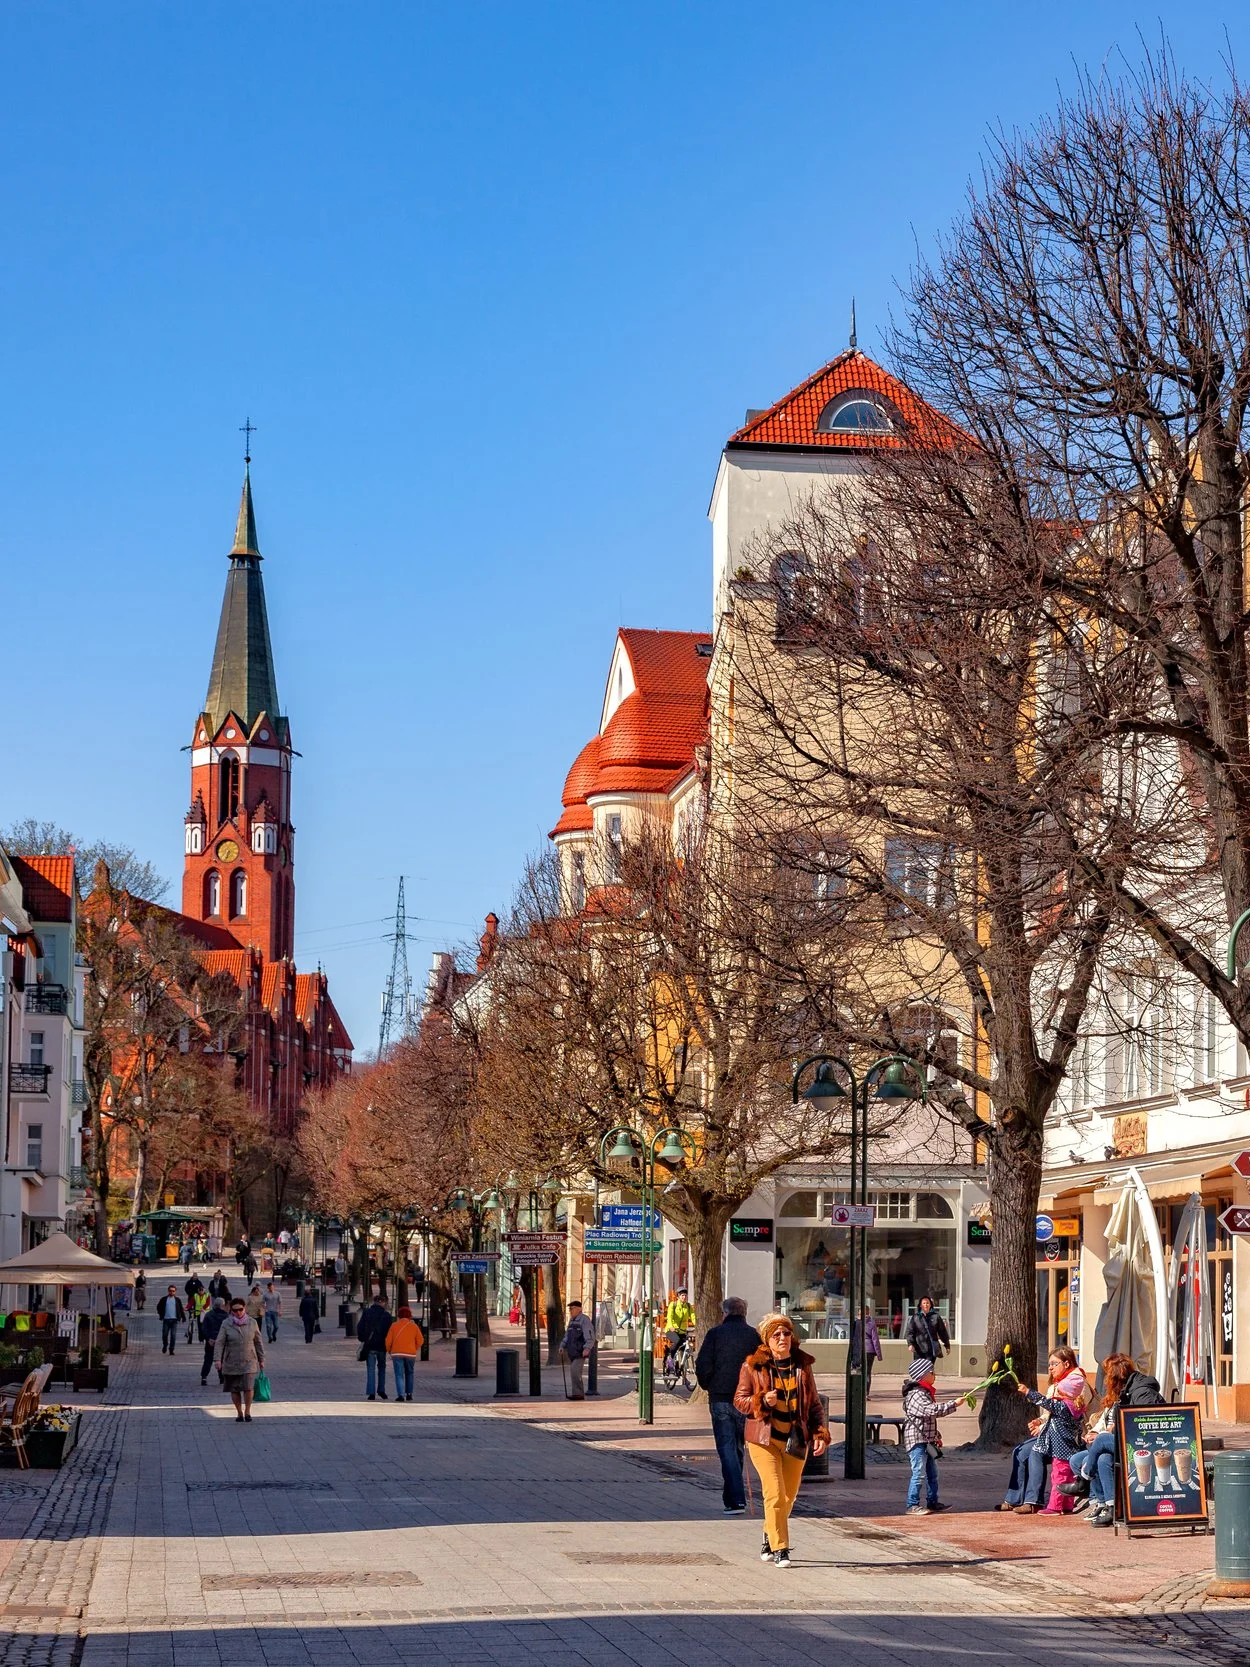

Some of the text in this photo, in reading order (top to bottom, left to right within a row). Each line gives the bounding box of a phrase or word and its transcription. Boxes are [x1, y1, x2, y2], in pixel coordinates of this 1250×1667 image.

[613, 1207, 628, 1216] Jana
[620, 1218, 644, 1226] Haffner
[733, 1223, 769, 1237] Sempre
[971, 1226, 992, 1236] Sem
[601, 1231, 630, 1239] Radiowej
[585, 1252, 613, 1260] Centrum
[1138, 1421, 1182, 1430] COFFEE ICE ART
